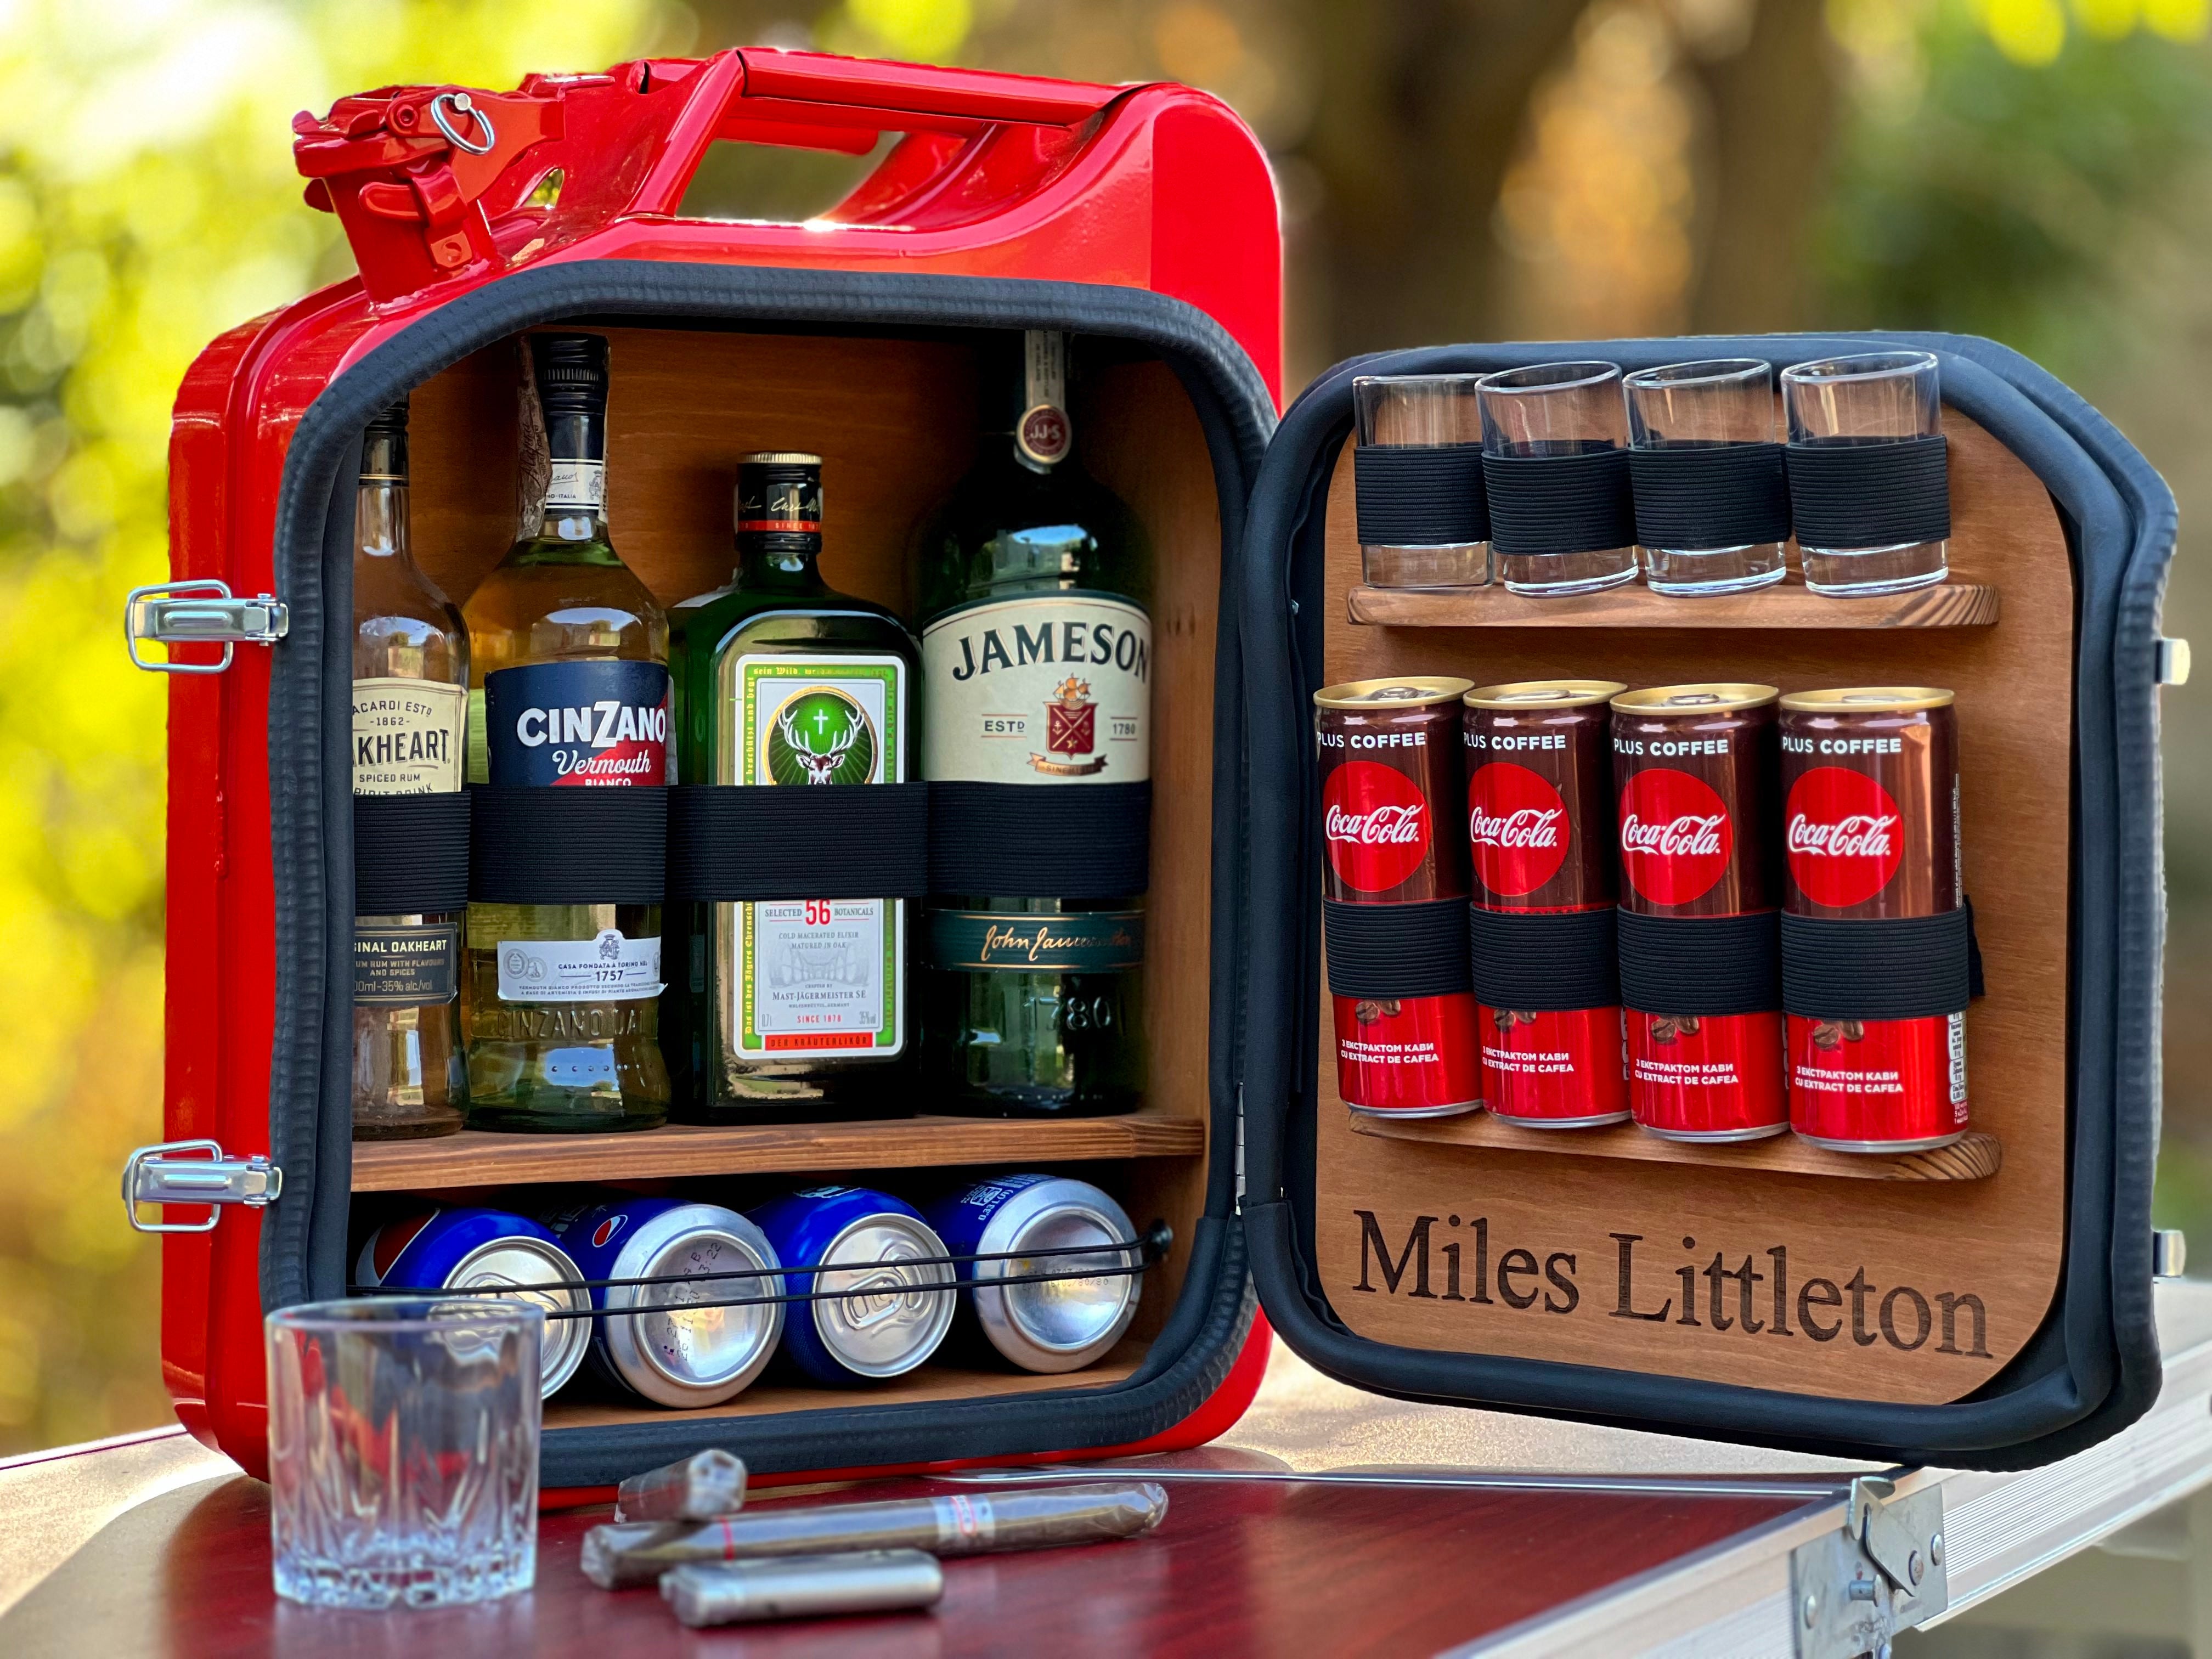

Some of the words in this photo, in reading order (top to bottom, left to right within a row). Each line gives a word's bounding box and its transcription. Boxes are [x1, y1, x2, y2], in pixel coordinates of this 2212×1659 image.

[952, 622, 1149, 684] JAMESON
[353, 701, 400, 716] ACARDI
[517, 701, 666, 747] CINZANO
[1113, 723, 1136, 735] 1780
[353, 729, 449, 766] KHEART
[1351, 732, 1426, 748] COFFEE
[1492, 735, 1566, 751] COFFEE
[1614, 737, 1643, 756] PLUS
[1650, 740, 1729, 757] COFFEE
[1782, 736, 1814, 753] PLUS
[1820, 738, 1901, 754] COFFEE
[552, 749, 651, 775] Vermouth
[359, 774, 396, 782] SPICED
[400, 774, 420, 782] RUM
[1326, 803, 1424, 844] Coca-Cola
[1470, 806, 1562, 848] Coca-Cola
[1622, 814, 1725, 855] Coca-Cola
[1788, 814, 1897, 856] Coca-Cola
[765, 909, 802, 917] SELECTED
[805, 899, 831, 926] 56
[834, 907, 873, 916] BOTANICALS
[745, 903, 753, 947] Ehrenschi
[392, 939, 447, 952] OAKHEART
[981, 924, 1029, 962] John
[596, 970, 624, 981] 1757
[772, 991, 854, 1001] MAST-JÄGERMEISTER
[856, 990, 866, 998] SE
[797, 1015, 820, 1023] SINCE
[824, 1014, 842, 1023] 1878
[771, 1039, 788, 1047] DER
[795, 1036, 867, 1046] KRÄUTERLIKÖR
[1346, 1040, 1402, 1052] ЕКСТРАКТОМ
[1404, 1042, 1434, 1052] КАВИ
[1348, 1052, 1385, 1063] EXTRACT
[1403, 1053, 1439, 1063] CAFEA
[1486, 1047, 1536, 1061] ЕКСТРАКТОМ
[1539, 1052, 1569, 1061] КАВИ
[1488, 1059, 1521, 1071] EXTRACT
[1522, 1064, 1536, 1073] DE
[1538, 1064, 1574, 1073] CAFEA
[1640, 1060, 1700, 1073] ЕКСТРАКТОМ
[1702, 1063, 1733, 1073] КАВИ
[1802, 1067, 1863, 1080] ЕКСТРАКТОМ
[1866, 1071, 1898, 1081] КАВИ
[1635, 1069, 1643, 1079] CU
[1643, 1071, 1681, 1084] EXTRACT
[1684, 1076, 1699, 1085] DE
[1701, 1075, 1739, 1085] CAFEA
[1795, 1078, 1803, 1087] CU
[1804, 1080, 1843, 1092] EXTRACT
[1847, 1084, 1862, 1093] DE
[1865, 1082, 1903, 1093] CAFEA
[1352, 1209, 1580, 1314] Miles
[1608, 1233, 1993, 1359] Littleton
